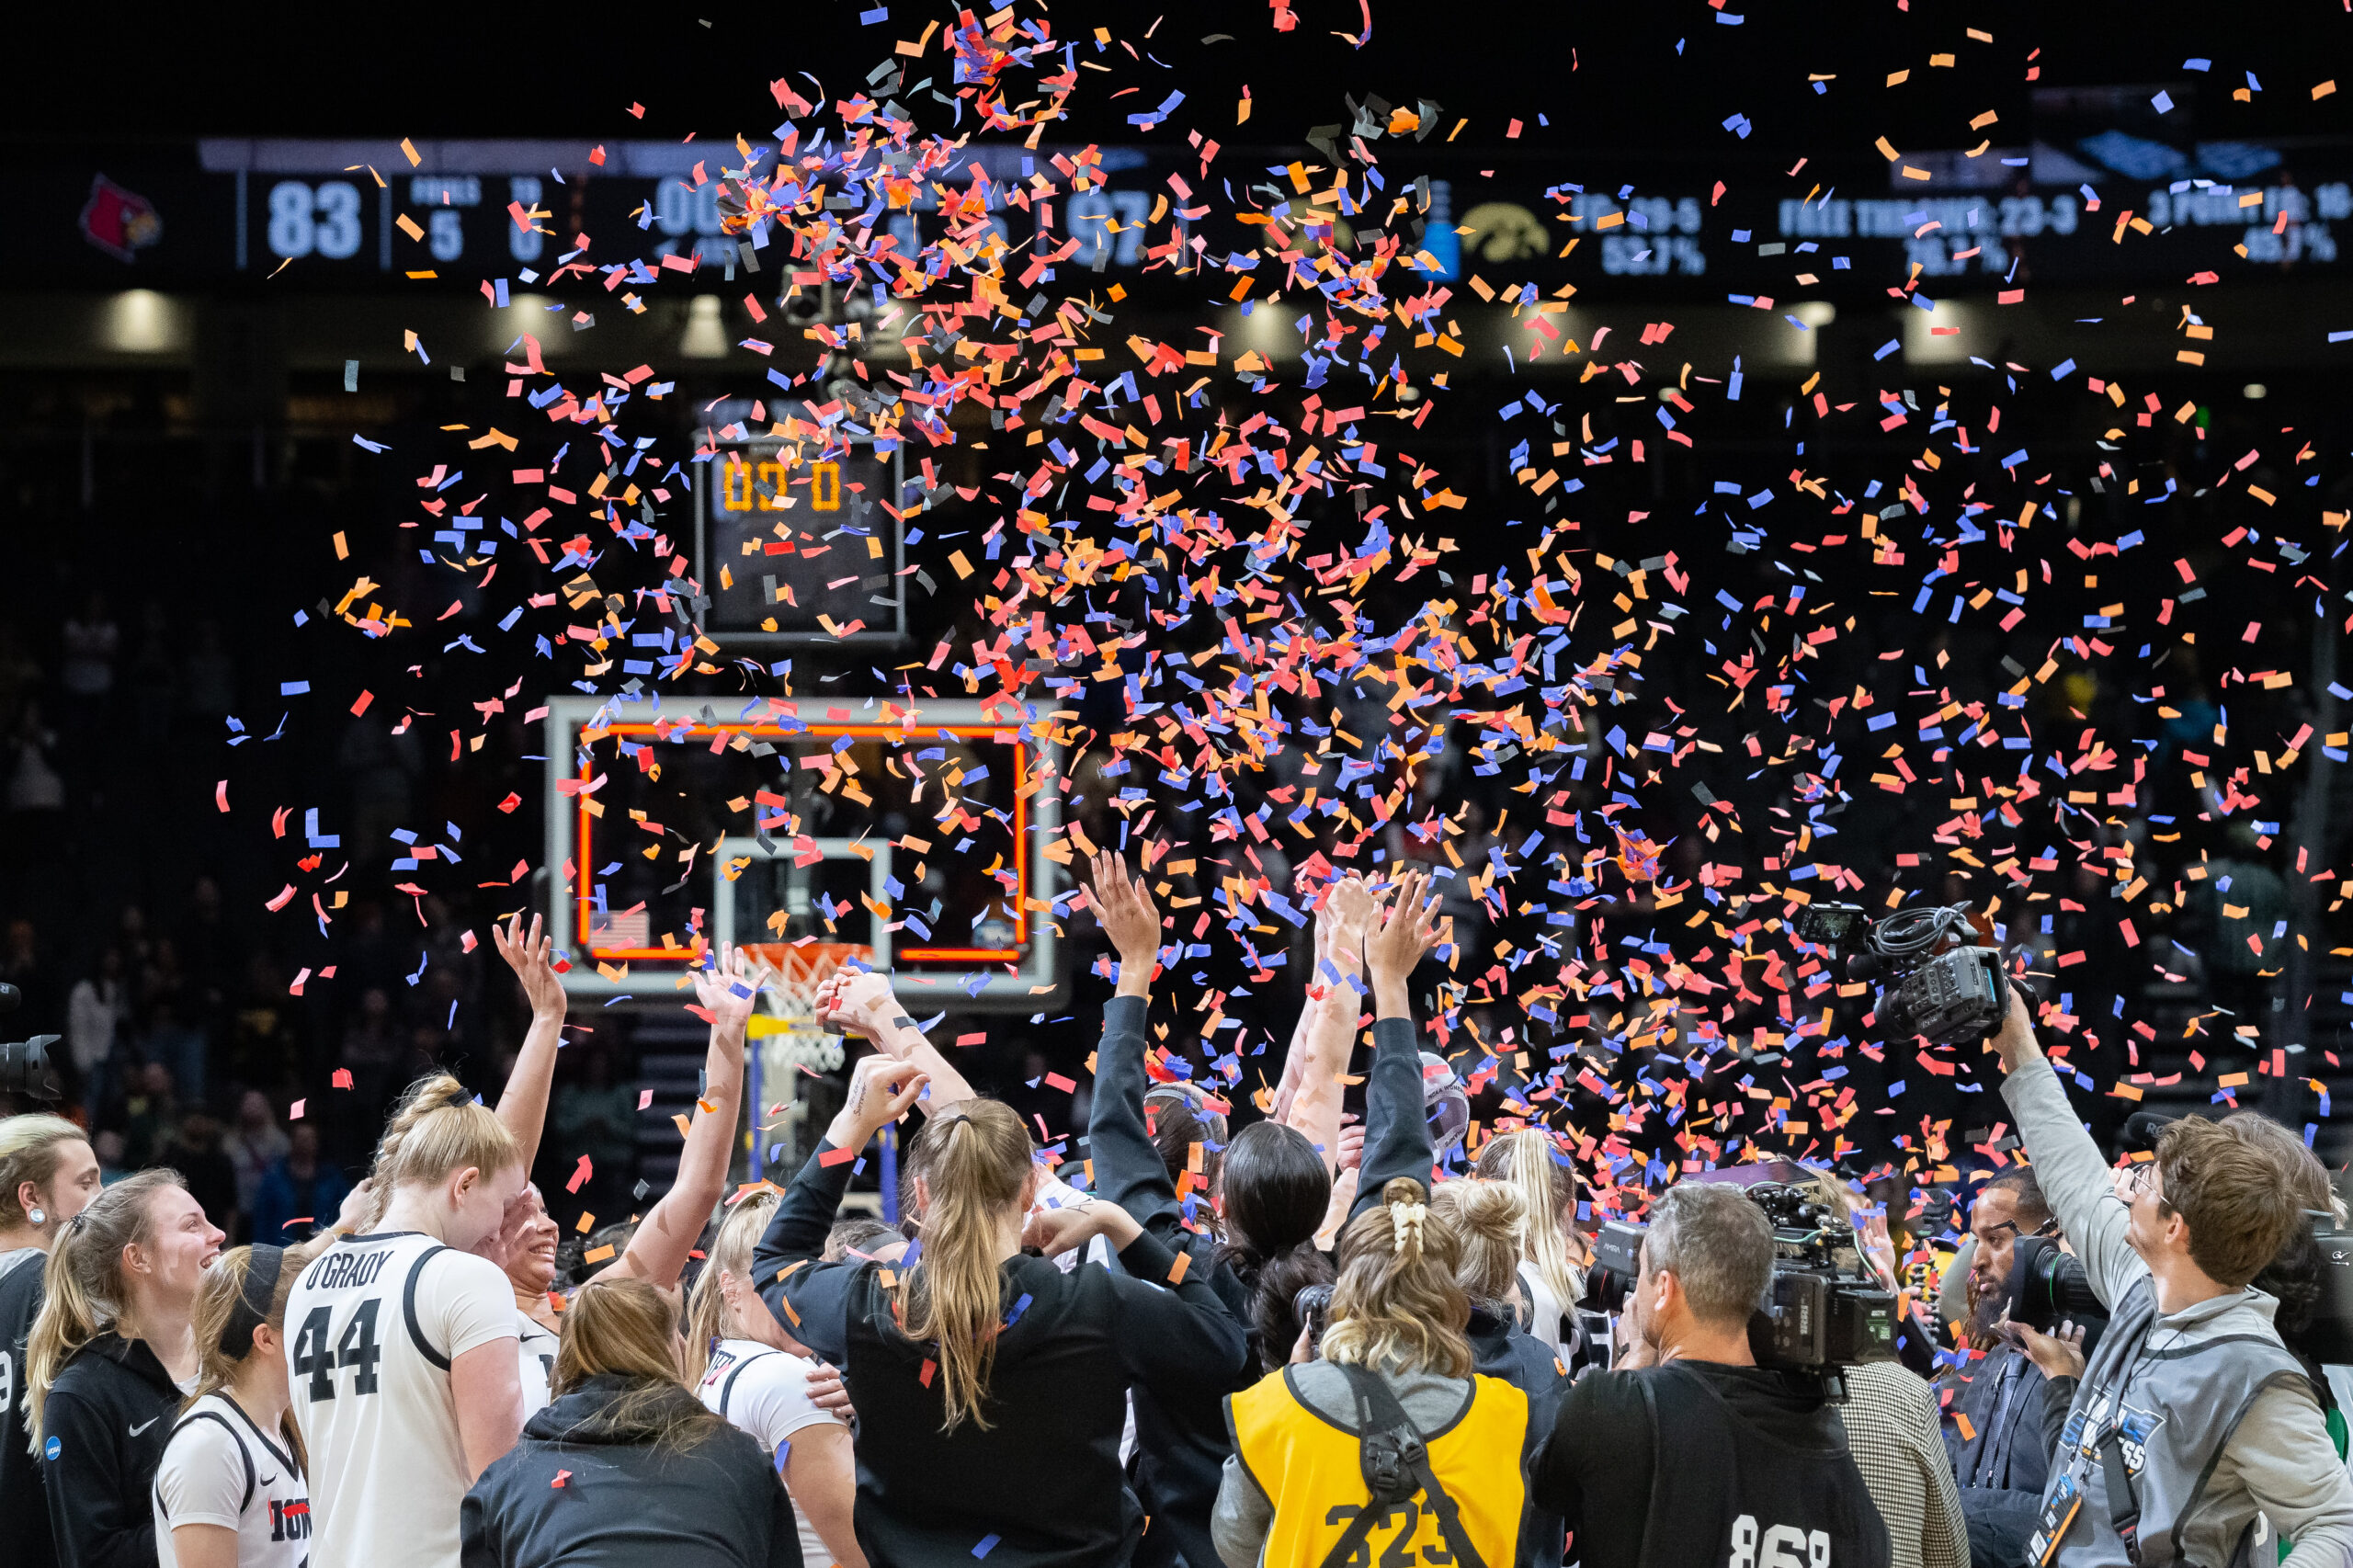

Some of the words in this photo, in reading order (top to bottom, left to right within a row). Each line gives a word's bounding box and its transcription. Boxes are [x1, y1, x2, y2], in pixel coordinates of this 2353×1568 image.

[268, 181, 362, 258] 83
[1066, 189, 1149, 267] 97
[306, 1251, 395, 1290] O'GRADY
[293, 1298, 382, 1403] 44
